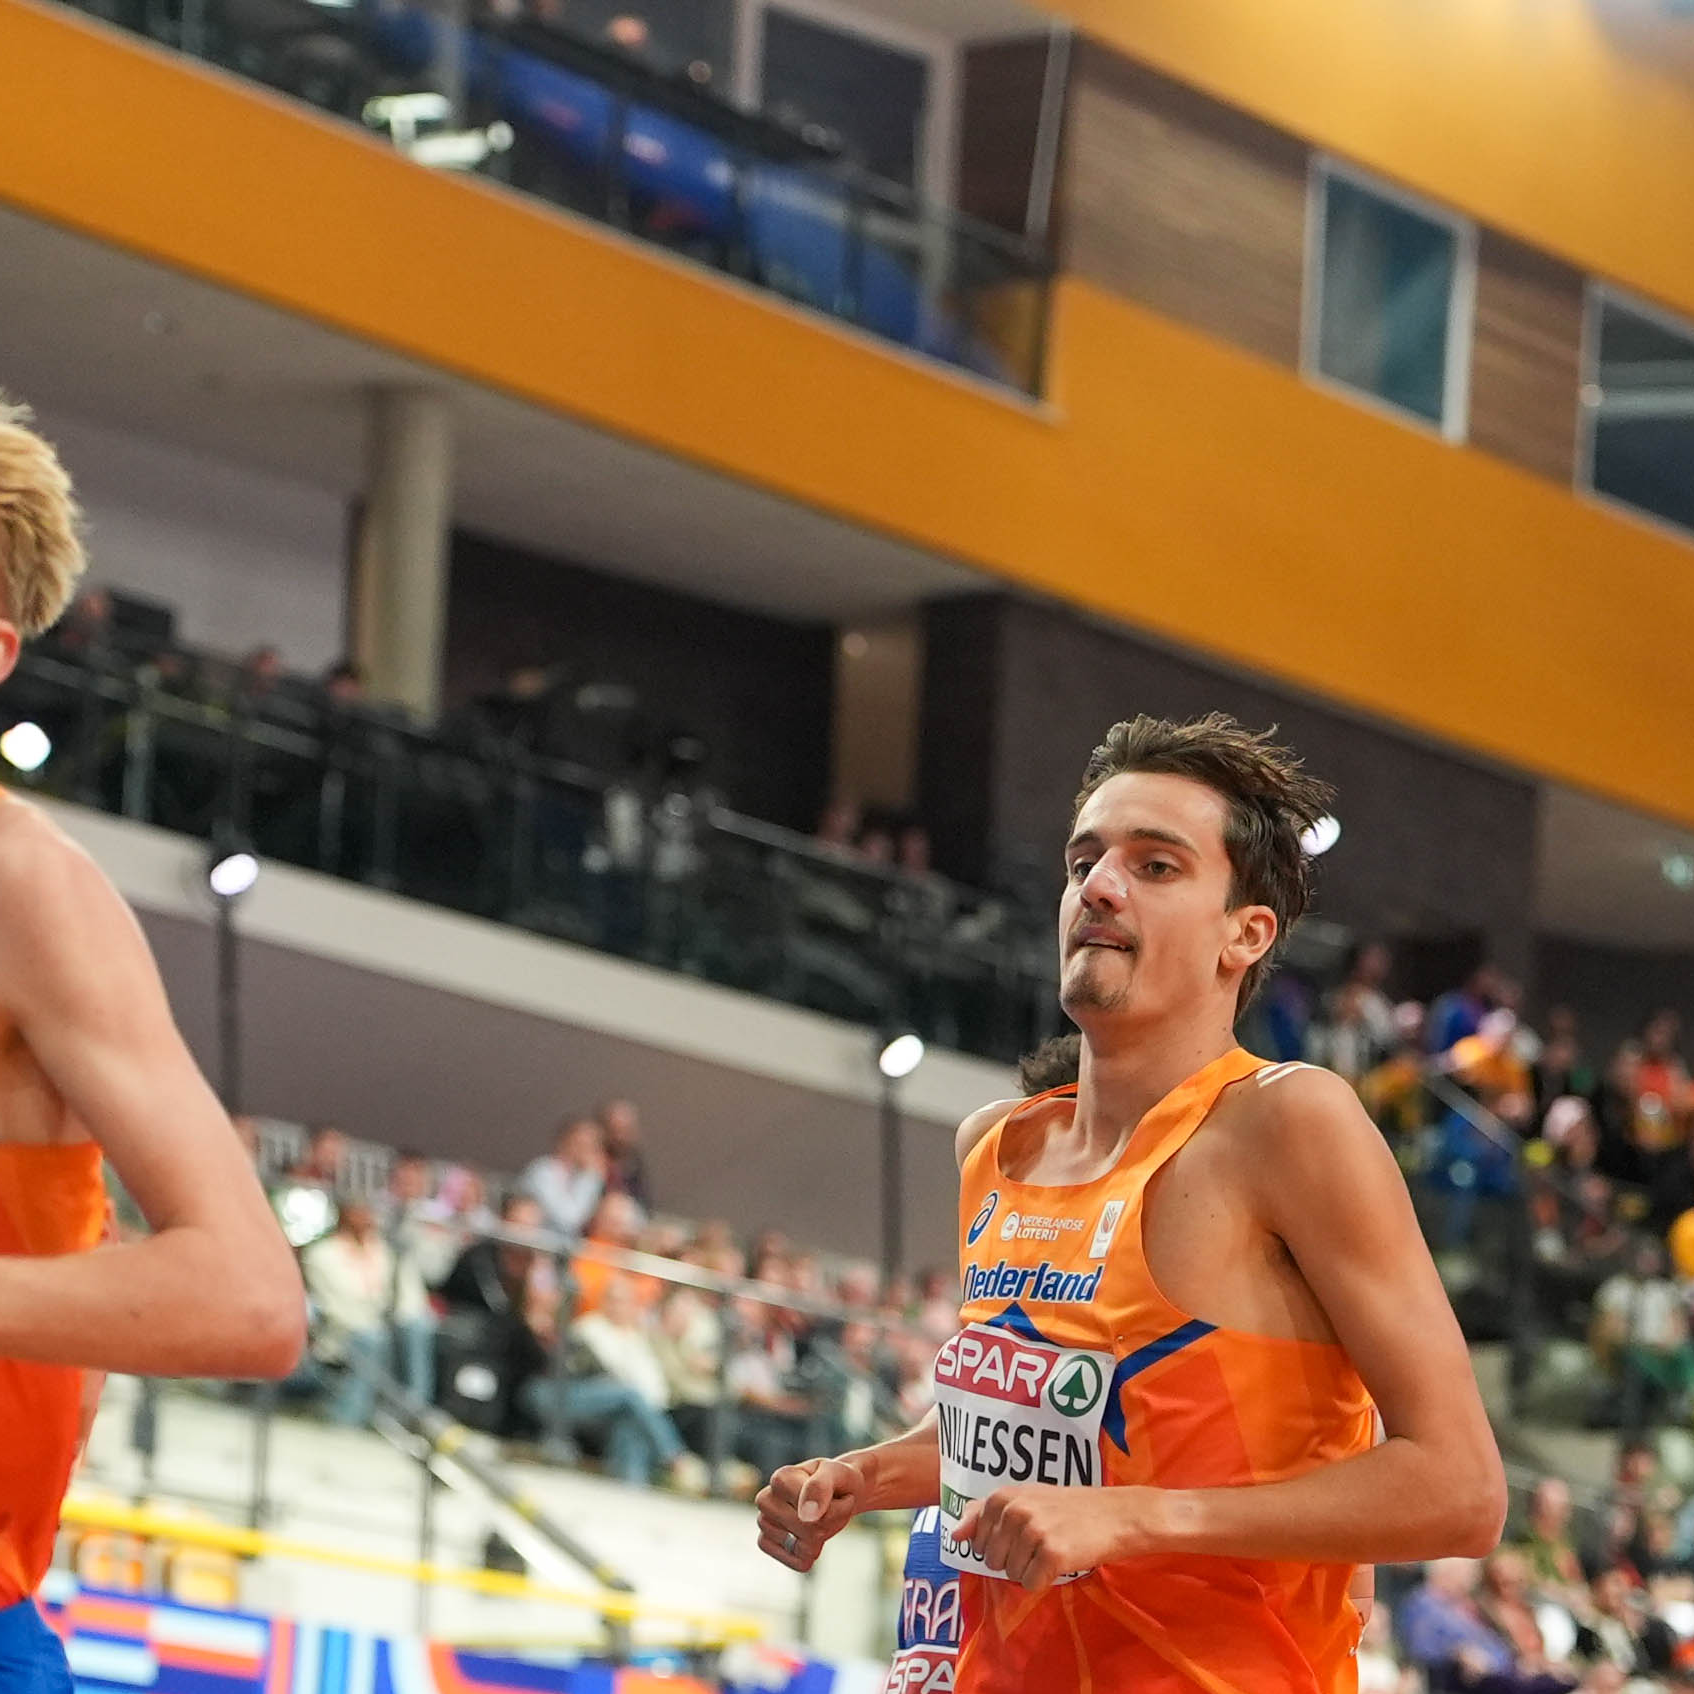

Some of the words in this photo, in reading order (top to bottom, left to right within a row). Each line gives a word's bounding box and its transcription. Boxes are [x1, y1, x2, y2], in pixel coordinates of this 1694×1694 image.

[1017, 1228, 1059, 1241] LOTERIJ
[1021, 1216, 1085, 1232] NEDERLANDSE
[937, 1336, 1048, 1398] SPAR
[938, 1402, 1093, 1487] NILLESSEN
[904, 1578, 964, 1642] FRA
